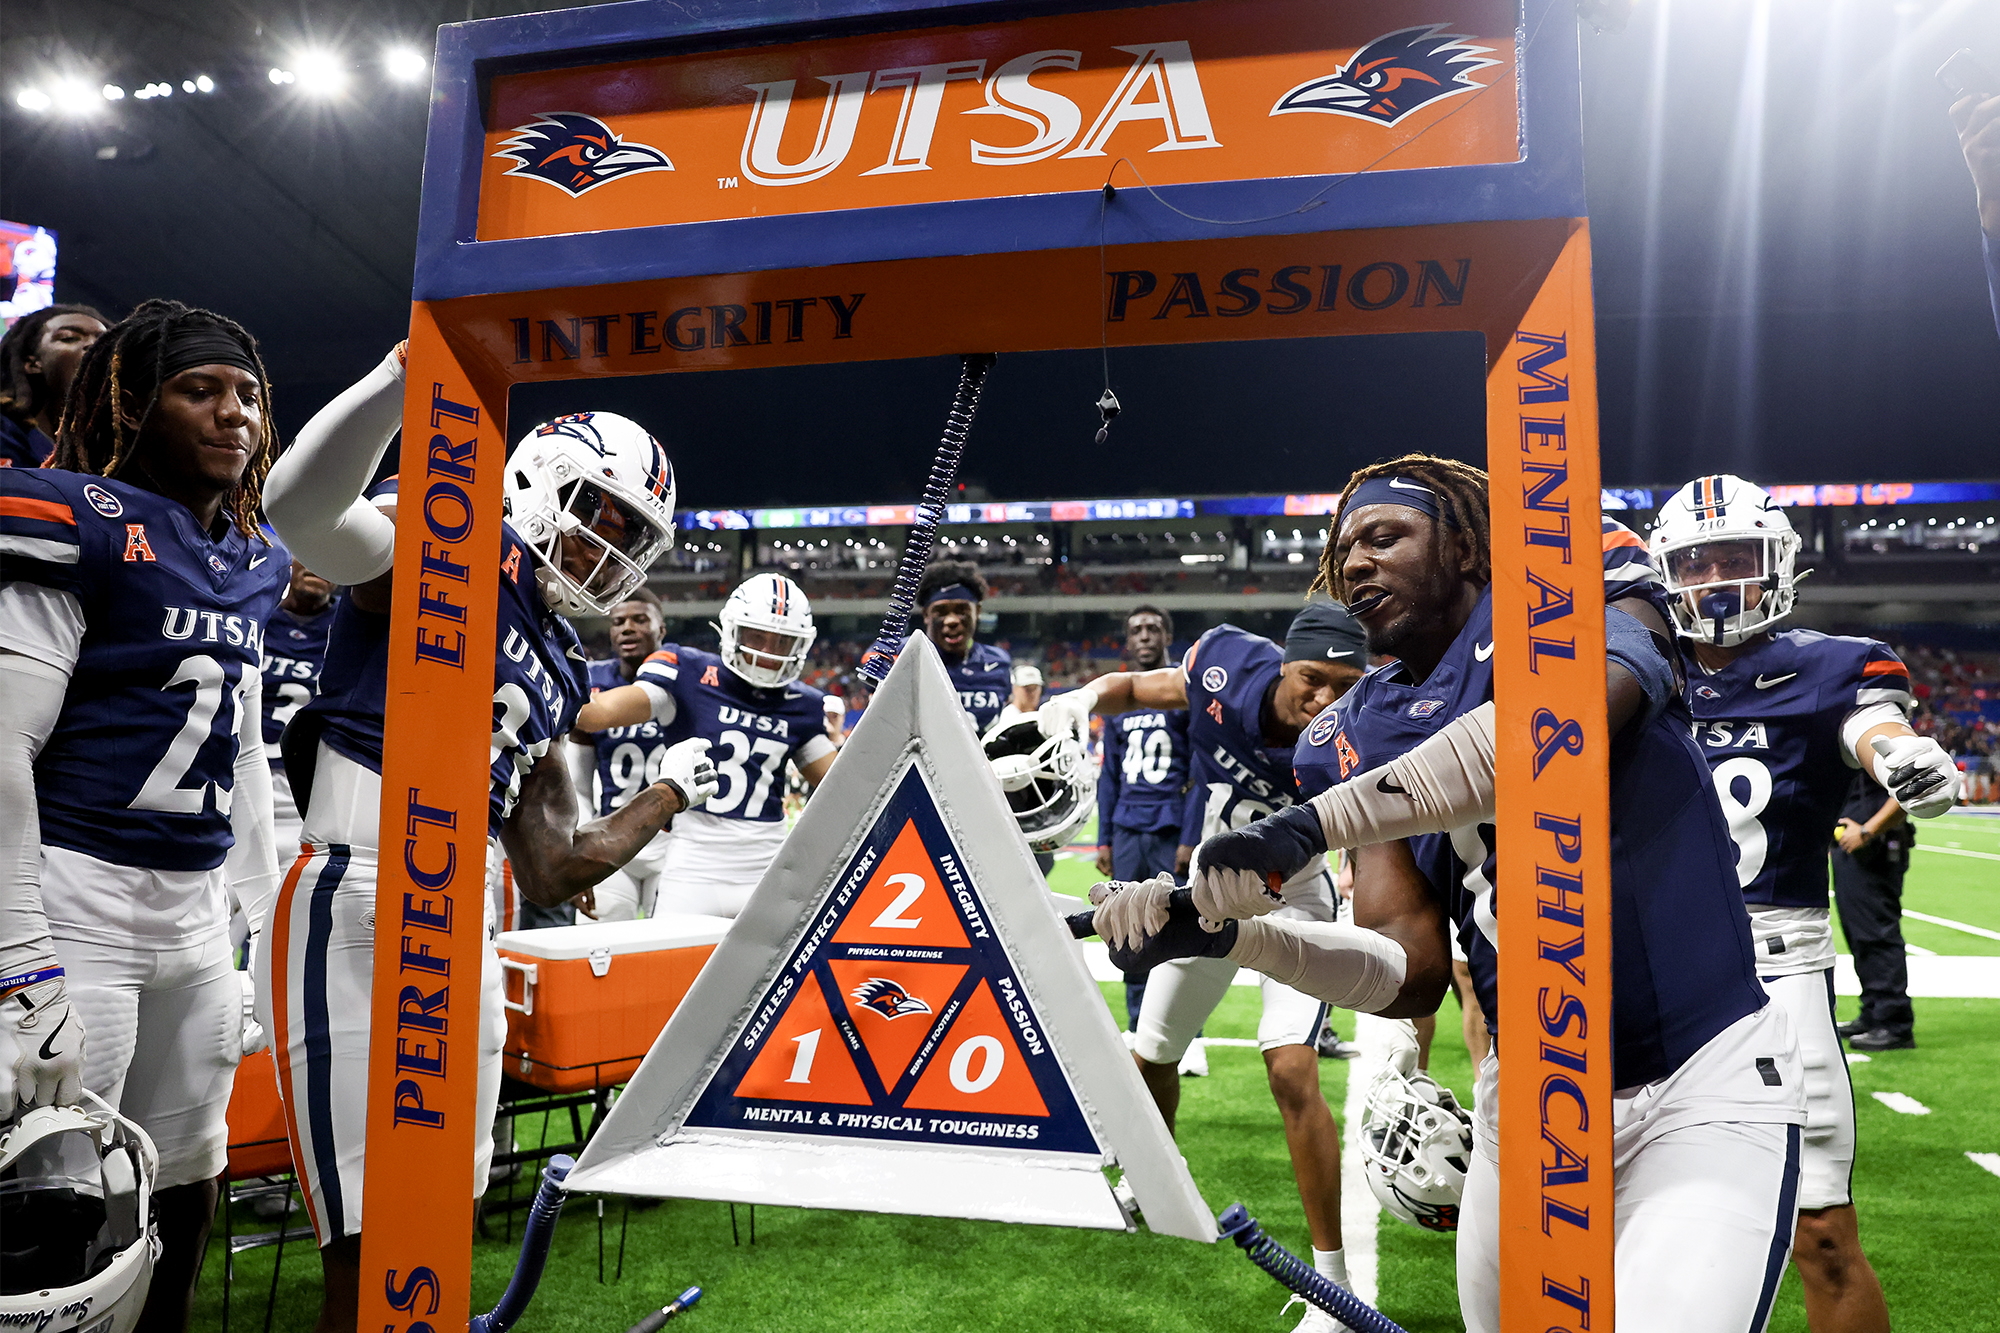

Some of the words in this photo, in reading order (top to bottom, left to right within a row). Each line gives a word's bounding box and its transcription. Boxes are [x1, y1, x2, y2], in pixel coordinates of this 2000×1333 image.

[741, 40, 1223, 187] UTSA
[717, 176, 739, 190] TM
[1105, 259, 1472, 323] PASSION
[510, 293, 866, 364] INTEGRITY
[415, 382, 480, 673] EFFORT
[1515, 329, 1577, 676] MENTAL
[1697, 518, 1726, 533] 210
[123, 523, 157, 562] A
[162, 605, 260, 651] UTSA
[502, 624, 565, 728] UTSA
[957, 691, 1000, 709] TSA
[718, 705, 790, 738] UTSA
[1122, 713, 1167, 732] UTSA
[1531, 707, 1584, 782] &
[705, 729, 790, 818] 37
[1121, 729, 1173, 785] 40
[1213, 744, 1294, 807] UTSA
[1333, 730, 1360, 780] A
[869, 872, 926, 929] 2
[939, 853, 990, 940] INTEGRITY
[394, 787, 458, 1130] PERFECT
[743, 975, 795, 1051] SELFLESS
[792, 909, 840, 974] PERFECT
[836, 846, 878, 909] EFFORT
[847, 947, 889, 957] PHYSICAL
[890, 949, 905, 958] ON
[905, 950, 944, 959] DEFENSE
[841, 1019, 861, 1051] TEAMS
[909, 1056, 924, 1077] RUN
[920, 1039, 935, 1058] THE
[930, 999, 961, 1042] FOOTBALL
[998, 976, 1045, 1056] PASSION
[1534, 811, 1590, 1239] PHYSICAL
[784, 1027, 822, 1084] 1
[948, 1034, 1005, 1094] 0
[743, 1106, 814, 1125] MENTAL
[818, 1111, 833, 1126] &
[837, 1113, 923, 1133] PHYSICAL
[928, 1118, 1040, 1140] TOUGHNESS
[60, 1294, 94, 1322] San
[384, 1266, 440, 1333] S
[1541, 1271, 1590, 1333] T
